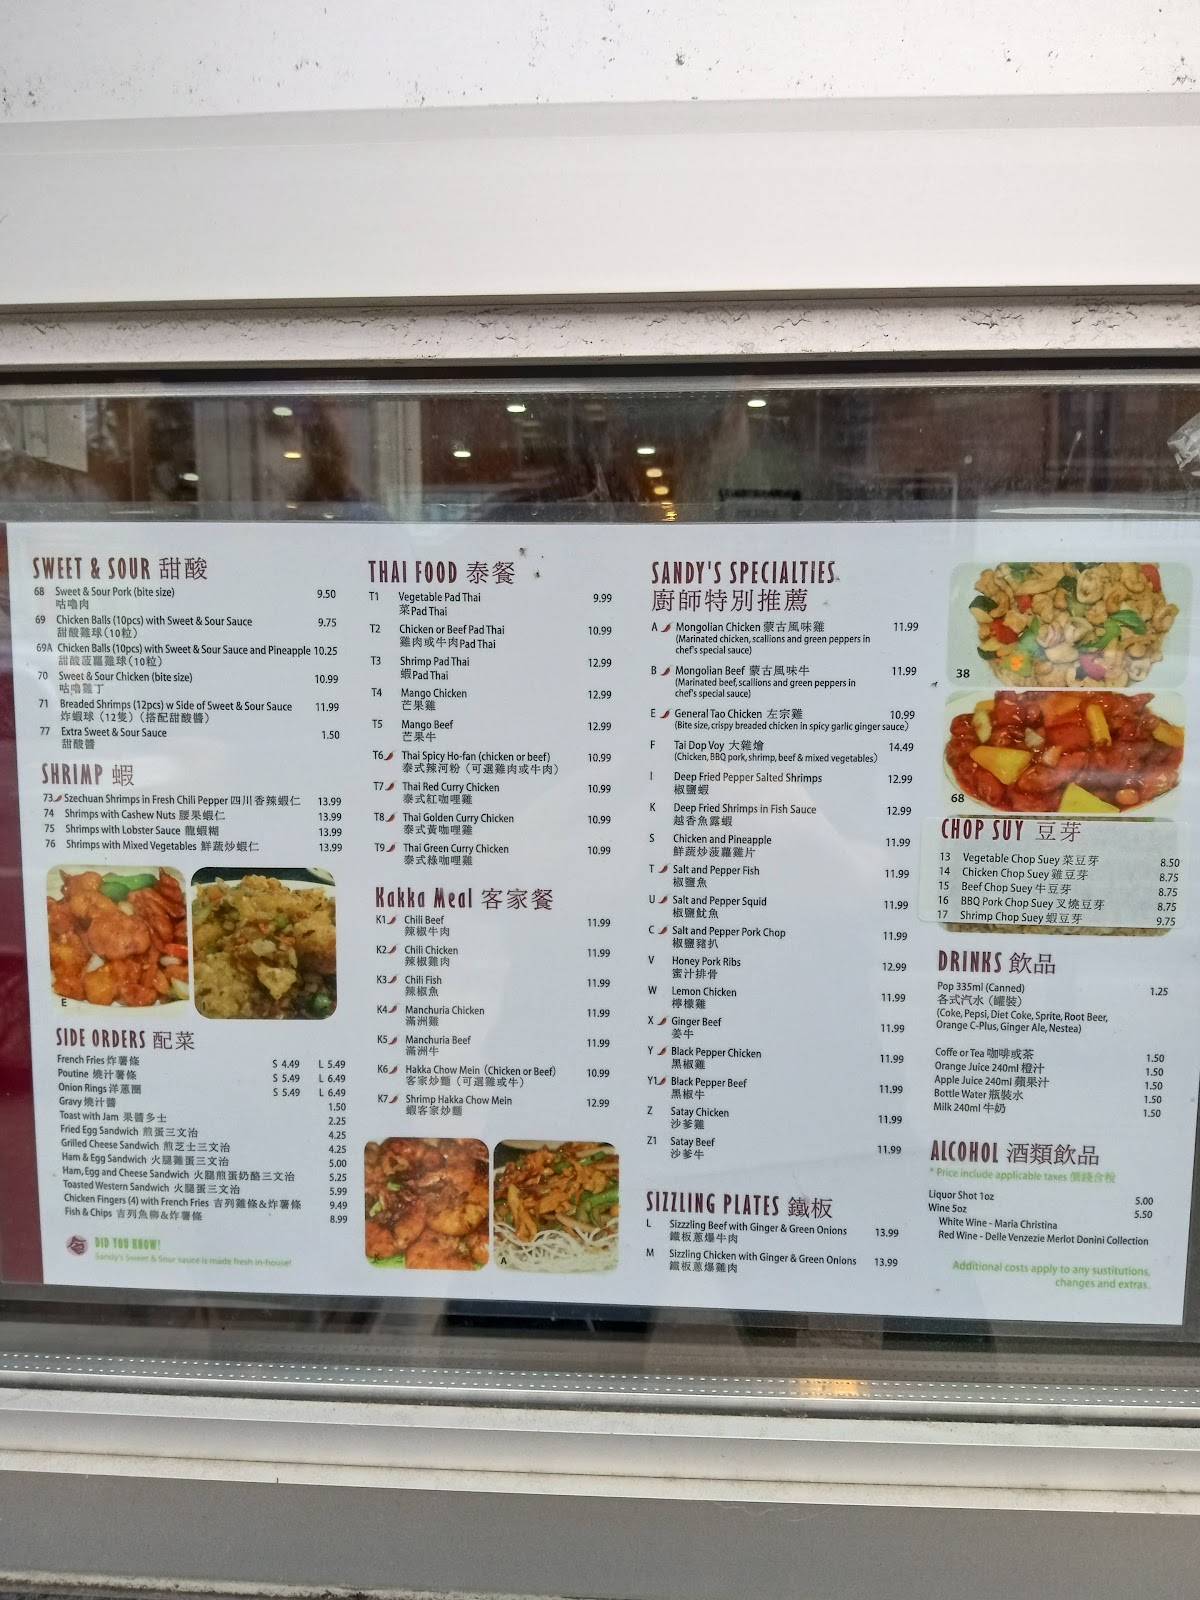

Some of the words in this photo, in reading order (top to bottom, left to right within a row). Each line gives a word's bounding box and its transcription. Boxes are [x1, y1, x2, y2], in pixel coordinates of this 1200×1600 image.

[32, 557, 82, 579] SWEET
[90, 557, 100, 579] &
[108, 557, 150, 579] SOUR
[159, 557, 207, 580] 甜酸
[368, 560, 407, 583] THAI
[415, 560, 457, 583] FOOD
[466, 561, 515, 584] 泰餐
[652, 561, 721, 584] SANDY'S
[730, 561, 835, 583] SPECIALTIES
[34, 586, 45, 596] 68
[55, 586, 81, 596] Sweet
[82, 586, 89, 596] &
[91, 586, 111, 596] Sour
[112, 586, 132, 596] Pork
[133, 586, 154, 598] (bite
[155, 587, 175, 598] size)
[317, 589, 336, 599] 9.50
[368, 591, 378, 600] T1
[398, 591, 442, 603] Vegetable
[444, 592, 461, 602] Pad
[462, 592, 480, 602] Thai
[593, 593, 612, 602] 9.99
[651, 622, 658, 631] A
[676, 622, 723, 634] Mongolian
[726, 622, 760, 631] Chicken
[894, 622, 918, 631] 11.99
[676, 634, 718, 644] (Marinated
[752, 634, 785, 643] scallions
[787, 634, 802, 643] and
[804, 636, 827, 645] green
[828, 636, 861, 645] peppers
[863, 634, 870, 643] in
[699, 645, 726, 655] special
[727, 646, 752, 655] sauce)
[956, 668, 970, 678] 38
[650, 708, 656, 717] E
[674, 708, 708, 718] General
[710, 709, 725, 718] Tao
[727, 708, 762, 718] Chicken
[890, 710, 915, 719] 10.99
[42, 762, 102, 785] SHRIMP
[112, 764, 134, 786] 蝦
[43, 793, 53, 802] 73
[64, 793, 104, 803] Szechuan
[105, 793, 140, 806] Shrimps
[142, 794, 150, 804] in
[152, 794, 175, 804] Fresh
[176, 795, 196, 804] Chili
[197, 795, 228, 807] Pepper
[318, 797, 341, 806] 13.99
[951, 793, 964, 802] 68
[373, 812, 384, 821] T8
[402, 812, 421, 822] Thai
[423, 812, 454, 822] Golden
[456, 813, 479, 824] Curry
[481, 813, 514, 823] Chicken
[588, 815, 611, 824] 10.99
[941, 818, 984, 840] CHOP
[992, 820, 1023, 840] SUY
[1035, 821, 1081, 842] 豆芽
[940, 852, 950, 861] 13
[963, 852, 1009, 864] Vegetable
[1011, 853, 1035, 865] Chop
[1037, 854, 1060, 866] Suey
[1160, 858, 1180, 867] 8.50
[649, 864, 654, 873] T
[673, 864, 689, 874] Salt
[691, 865, 707, 874] and
[710, 865, 740, 877] Pepper
[743, 865, 759, 875] Fish
[885, 869, 909, 878] 11.99
[376, 887, 425, 908] Kakka
[433, 887, 472, 908] Meal
[939, 895, 948, 904] 16
[961, 896, 980, 906] BBQ
[982, 896, 1003, 906] Pork
[1004, 897, 1029, 909] Chop
[1031, 898, 1053, 910] Suey
[1157, 902, 1176, 911] 8.75
[376, 915, 385, 924] K1
[404, 914, 423, 924] Chili
[425, 915, 444, 924] Beef
[587, 918, 610, 927] 11.99
[938, 950, 1002, 973] DRINKS
[1009, 952, 1055, 974] 飲品
[937, 981, 954, 992] Pop
[956, 982, 983, 991] 335ml
[985, 982, 1024, 994] (Canned)
[1150, 987, 1168, 996] 1.25
[61, 998, 67, 1007] E
[56, 1027, 85, 1047] SIDE
[92, 1029, 145, 1048] ORDERS
[153, 1031, 195, 1050] 配菜
[57, 1054, 84, 1063] French
[86, 1055, 105, 1064] Fries
[272, 1059, 277, 1068] S
[281, 1059, 299, 1068] 4.49
[318, 1059, 324, 1069] L
[327, 1060, 346, 1069] 5.49
[935, 1047, 957, 1057] Coffe
[970, 1048, 984, 1057] Tea
[1147, 1053, 1164, 1063] 1.50
[377, 1094, 388, 1103] K7
[405, 1094, 437, 1105] Shrimp
[438, 1095, 464, 1104] Hakka
[466, 1095, 490, 1104] Chow
[492, 1096, 513, 1105] Mein
[587, 1098, 610, 1107] 12.99
[647, 1135, 656, 1144] Z1
[670, 1136, 694, 1148] Satay
[695, 1137, 715, 1147] Beef
[877, 1145, 901, 1154] 11.99
[930, 1140, 998, 1163] ALCOHOL
[928, 1189, 956, 1201] Liquor
[957, 1190, 977, 1200] Shot
[979, 1192, 994, 1200] 1oz
[1135, 1196, 1153, 1205] 5.00
[646, 1191, 715, 1214] SIZZLING
[723, 1194, 779, 1216] PLATES
[787, 1196, 832, 1219] 鐵板
[646, 1218, 651, 1227] L
[669, 1219, 706, 1231] Sizzzling
[708, 1220, 727, 1230] Beef
[728, 1221, 747, 1231] with
[750, 1222, 778, 1234] Ginger
[780, 1223, 787, 1232] &
[789, 1224, 815, 1234] Green
[816, 1225, 847, 1235] Onions
[875, 1228, 899, 1237] 13.99
[500, 1257, 507, 1265] A
[952, 1260, 1002, 1272] Additional
[1004, 1264, 1029, 1272] costs
[1030, 1264, 1058, 1276] apply
[1060, 1265, 1070, 1274] to
[1071, 1266, 1090, 1277] any
[1055, 1278, 1095, 1290] changes
[1097, 1279, 1116, 1288] and
